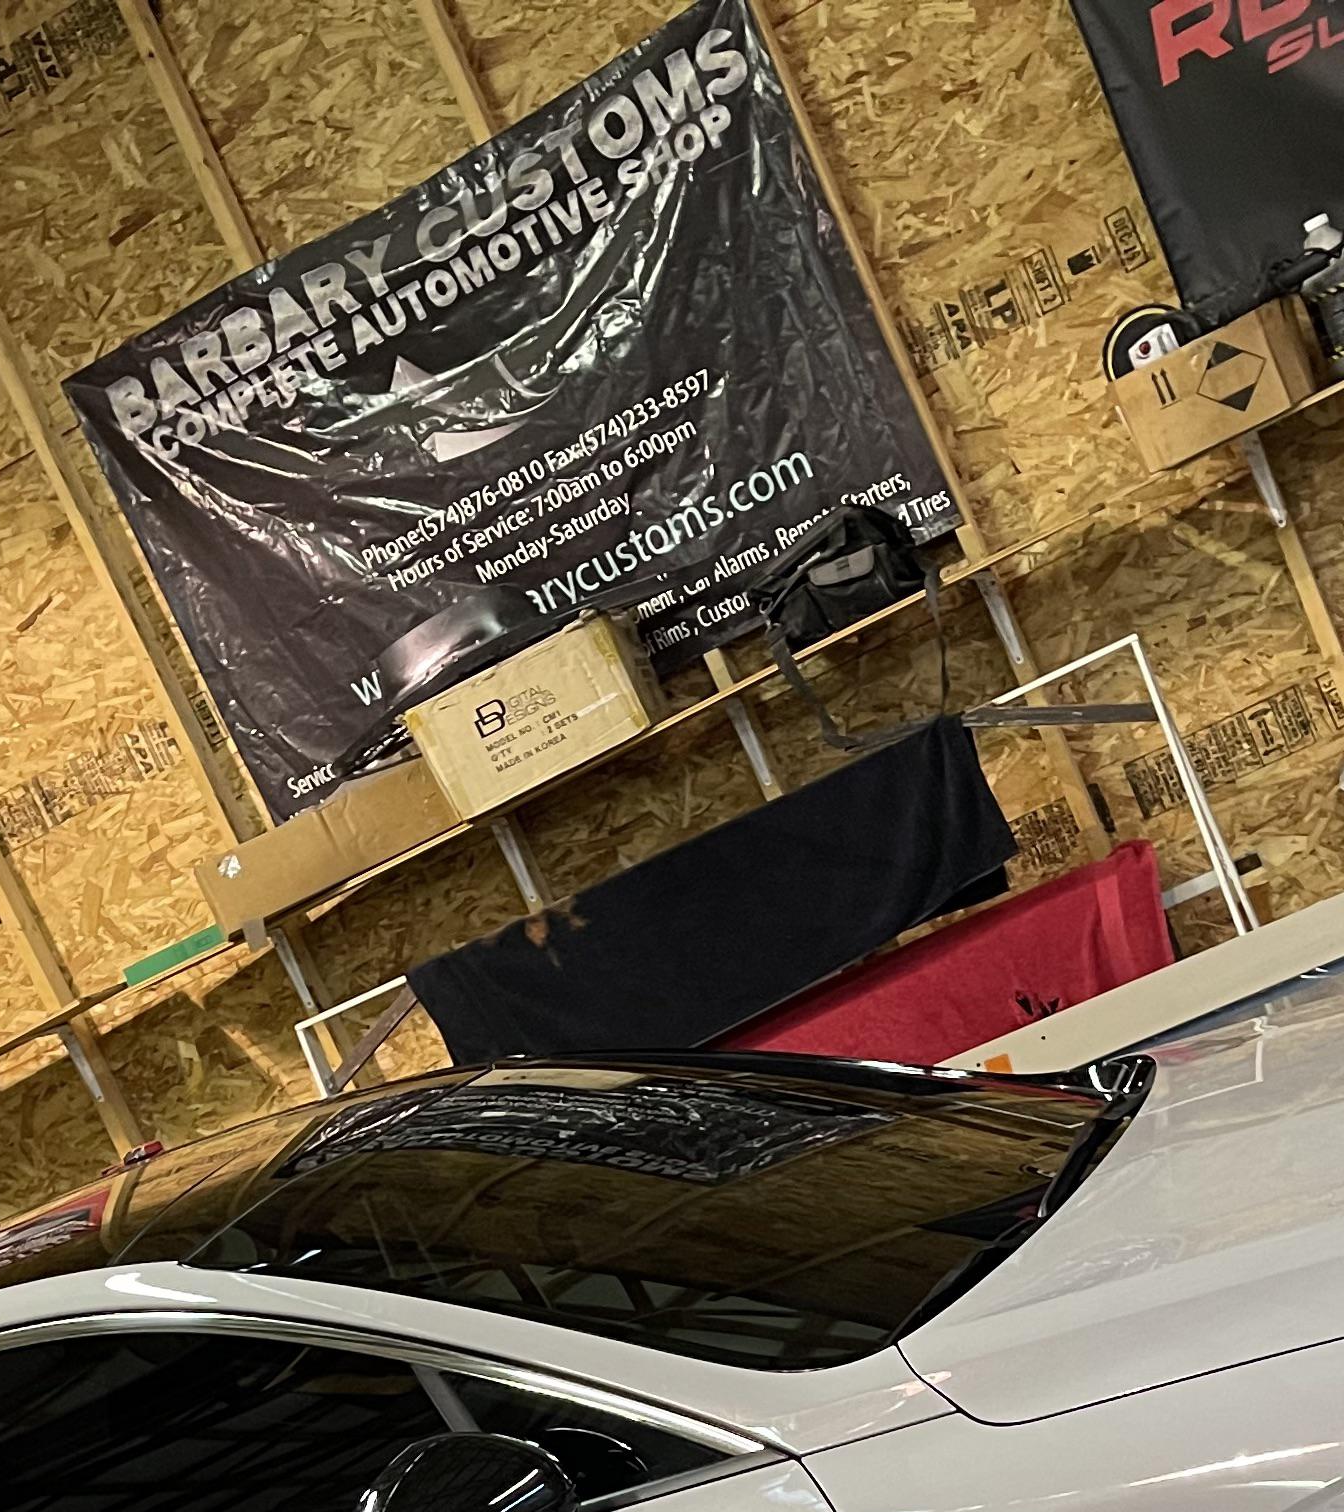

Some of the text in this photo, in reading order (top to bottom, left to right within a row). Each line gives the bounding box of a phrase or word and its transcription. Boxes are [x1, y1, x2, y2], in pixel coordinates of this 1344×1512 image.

[105, 28, 748, 437] BARBARY CUSTOMS
[152, 104, 732, 461] COMPLETE AUTOMOTIVE SHOP
[387, 420, 698, 592] Hours of Service: 7:00am to 6:00pm
[476, 493, 631, 584] Monday-Saturday
[908, 491, 952, 522] Tires
[496, 755, 522, 773] MADE
[535, 733, 567, 754] KOREA
